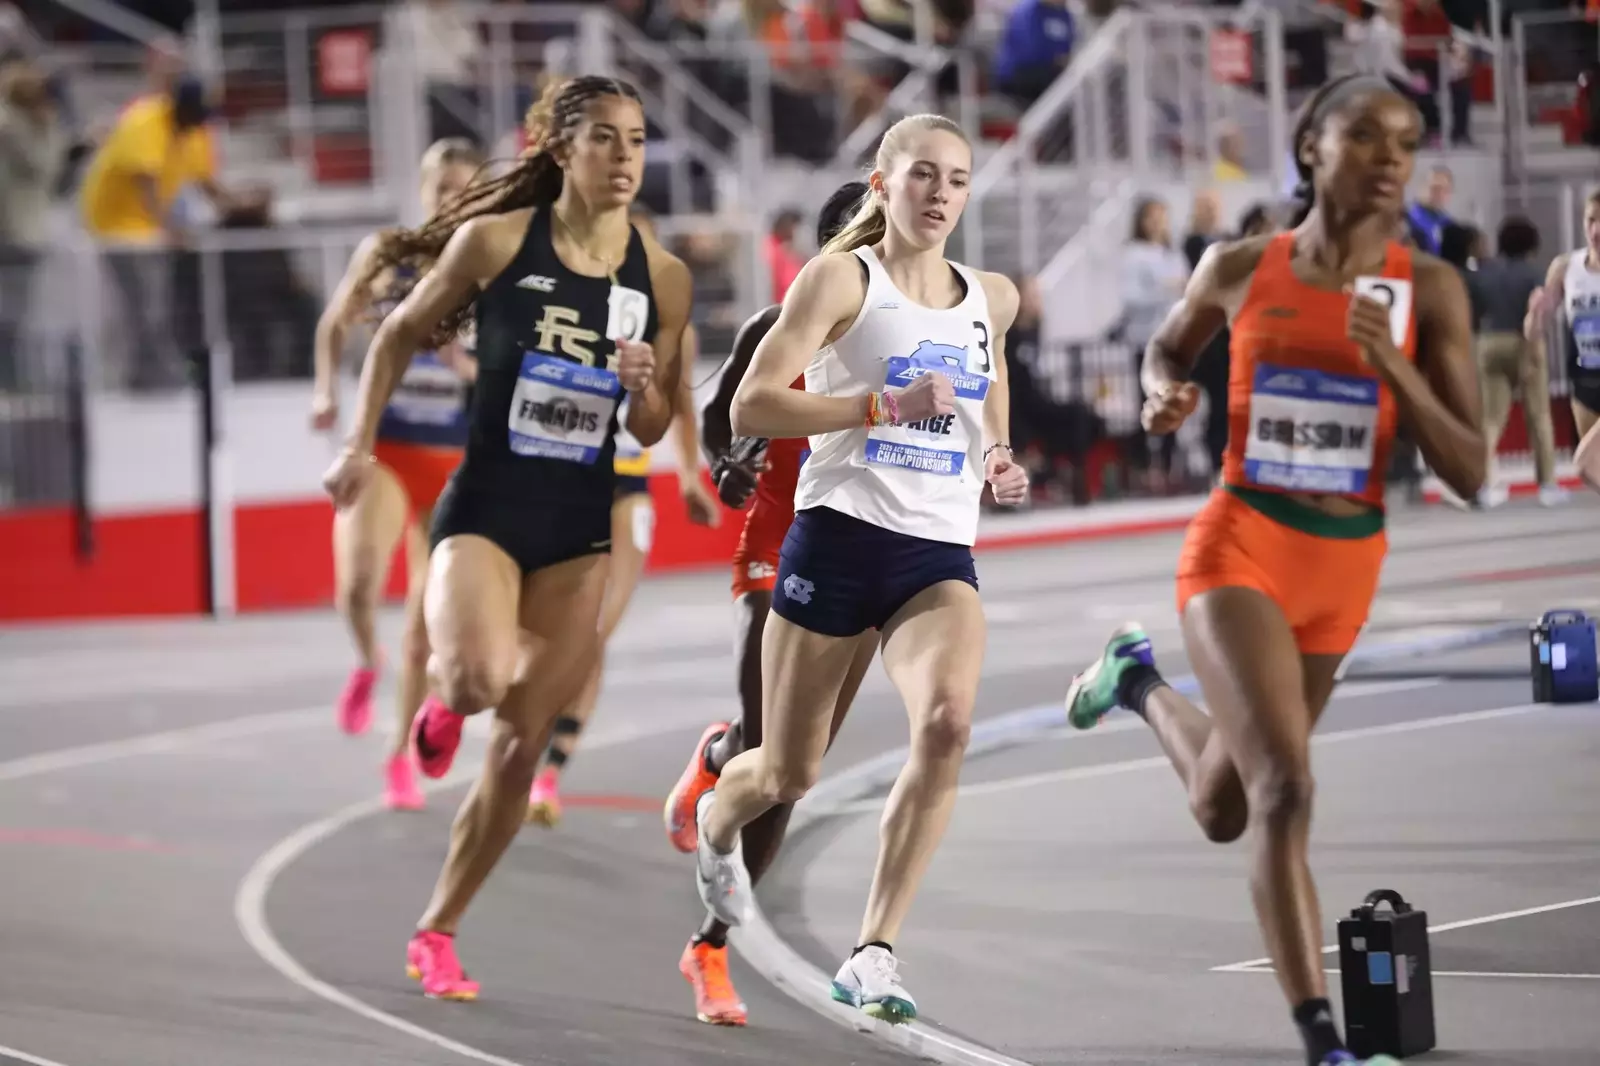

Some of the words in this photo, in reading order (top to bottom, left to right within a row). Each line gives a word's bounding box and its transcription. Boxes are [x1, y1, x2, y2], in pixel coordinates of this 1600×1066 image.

[516, 274, 558, 293] ACC
[620, 294, 639, 341] 6
[972, 320, 990, 373] 3
[895, 366, 927, 380] AC
[518, 400, 600, 432] FRANCIS
[895, 413, 956, 435] AIGE
[876, 449, 953, 472] CHAMPIONSHIPS
